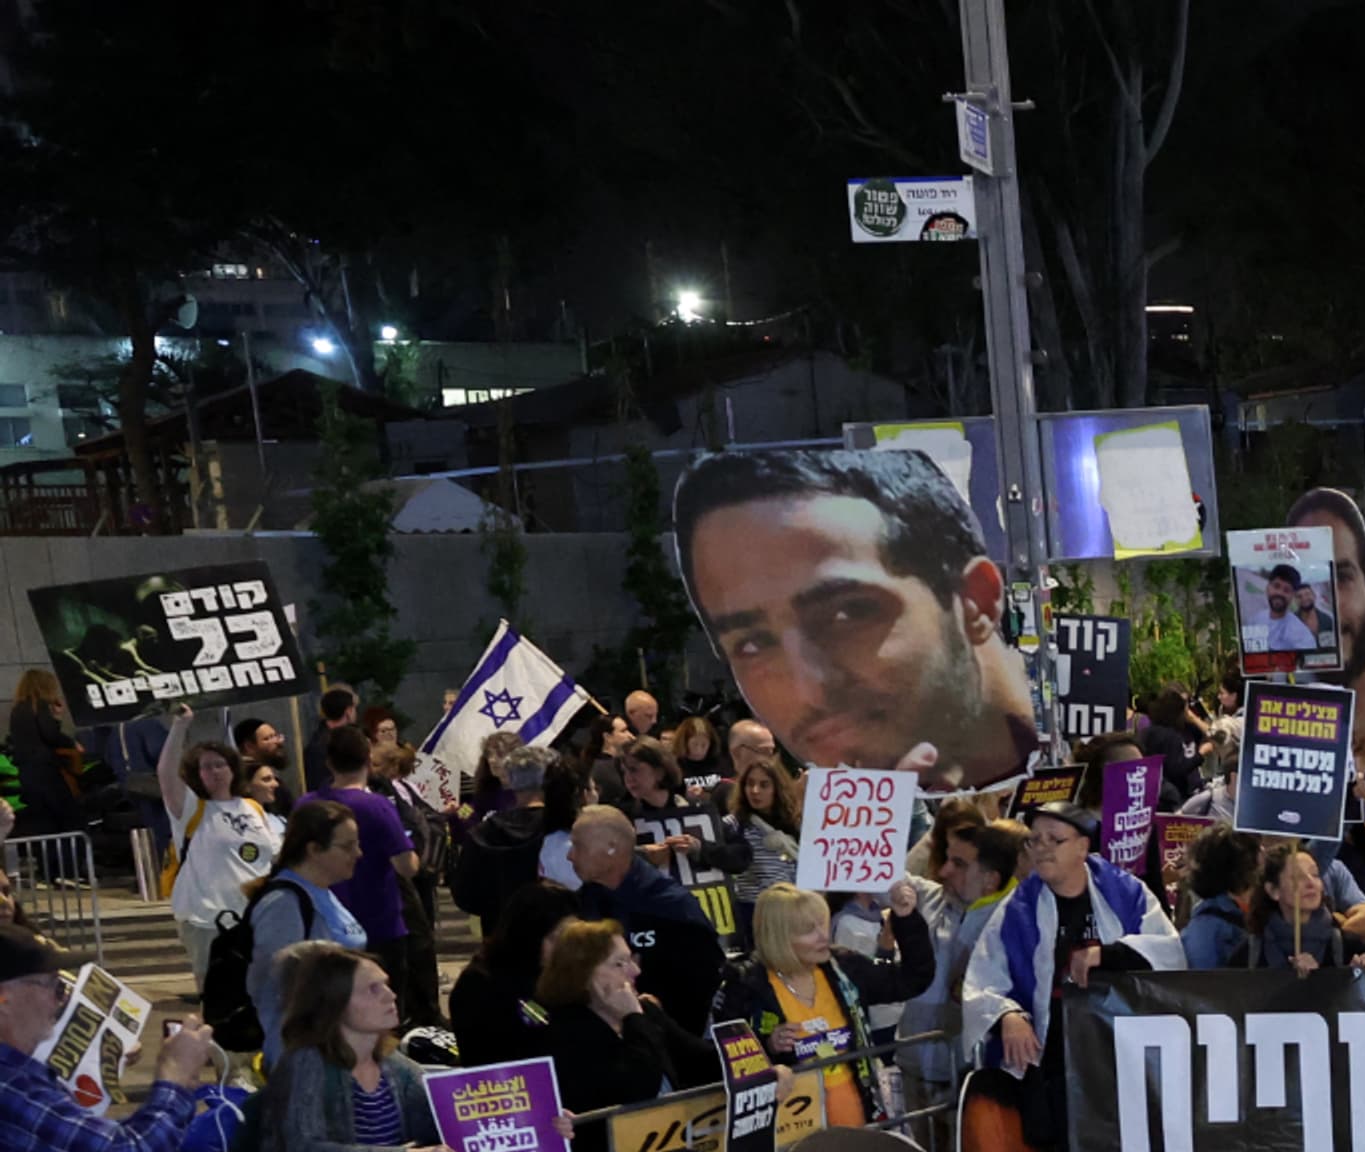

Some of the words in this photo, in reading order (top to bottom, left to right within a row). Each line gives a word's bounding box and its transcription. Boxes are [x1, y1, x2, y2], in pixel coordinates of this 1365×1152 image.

[159, 580, 268, 618] קודם
[166, 609, 283, 667] כל
[1054, 618, 1119, 662] קוד
[86, 655, 297, 709] החטופים!
[1259, 699, 1284, 717] את
[1285, 702, 1339, 721] מצילים
[1257, 716, 1337, 740] החטופים
[1253, 743, 1337, 772] מסרבים
[819, 770, 895, 803] סרבל
[1251, 768, 1335, 796] למלחמה
[820, 803, 894, 831] כתום
[824, 860, 895, 888] בזדון
[458, 1095, 528, 1118] הסכמים
